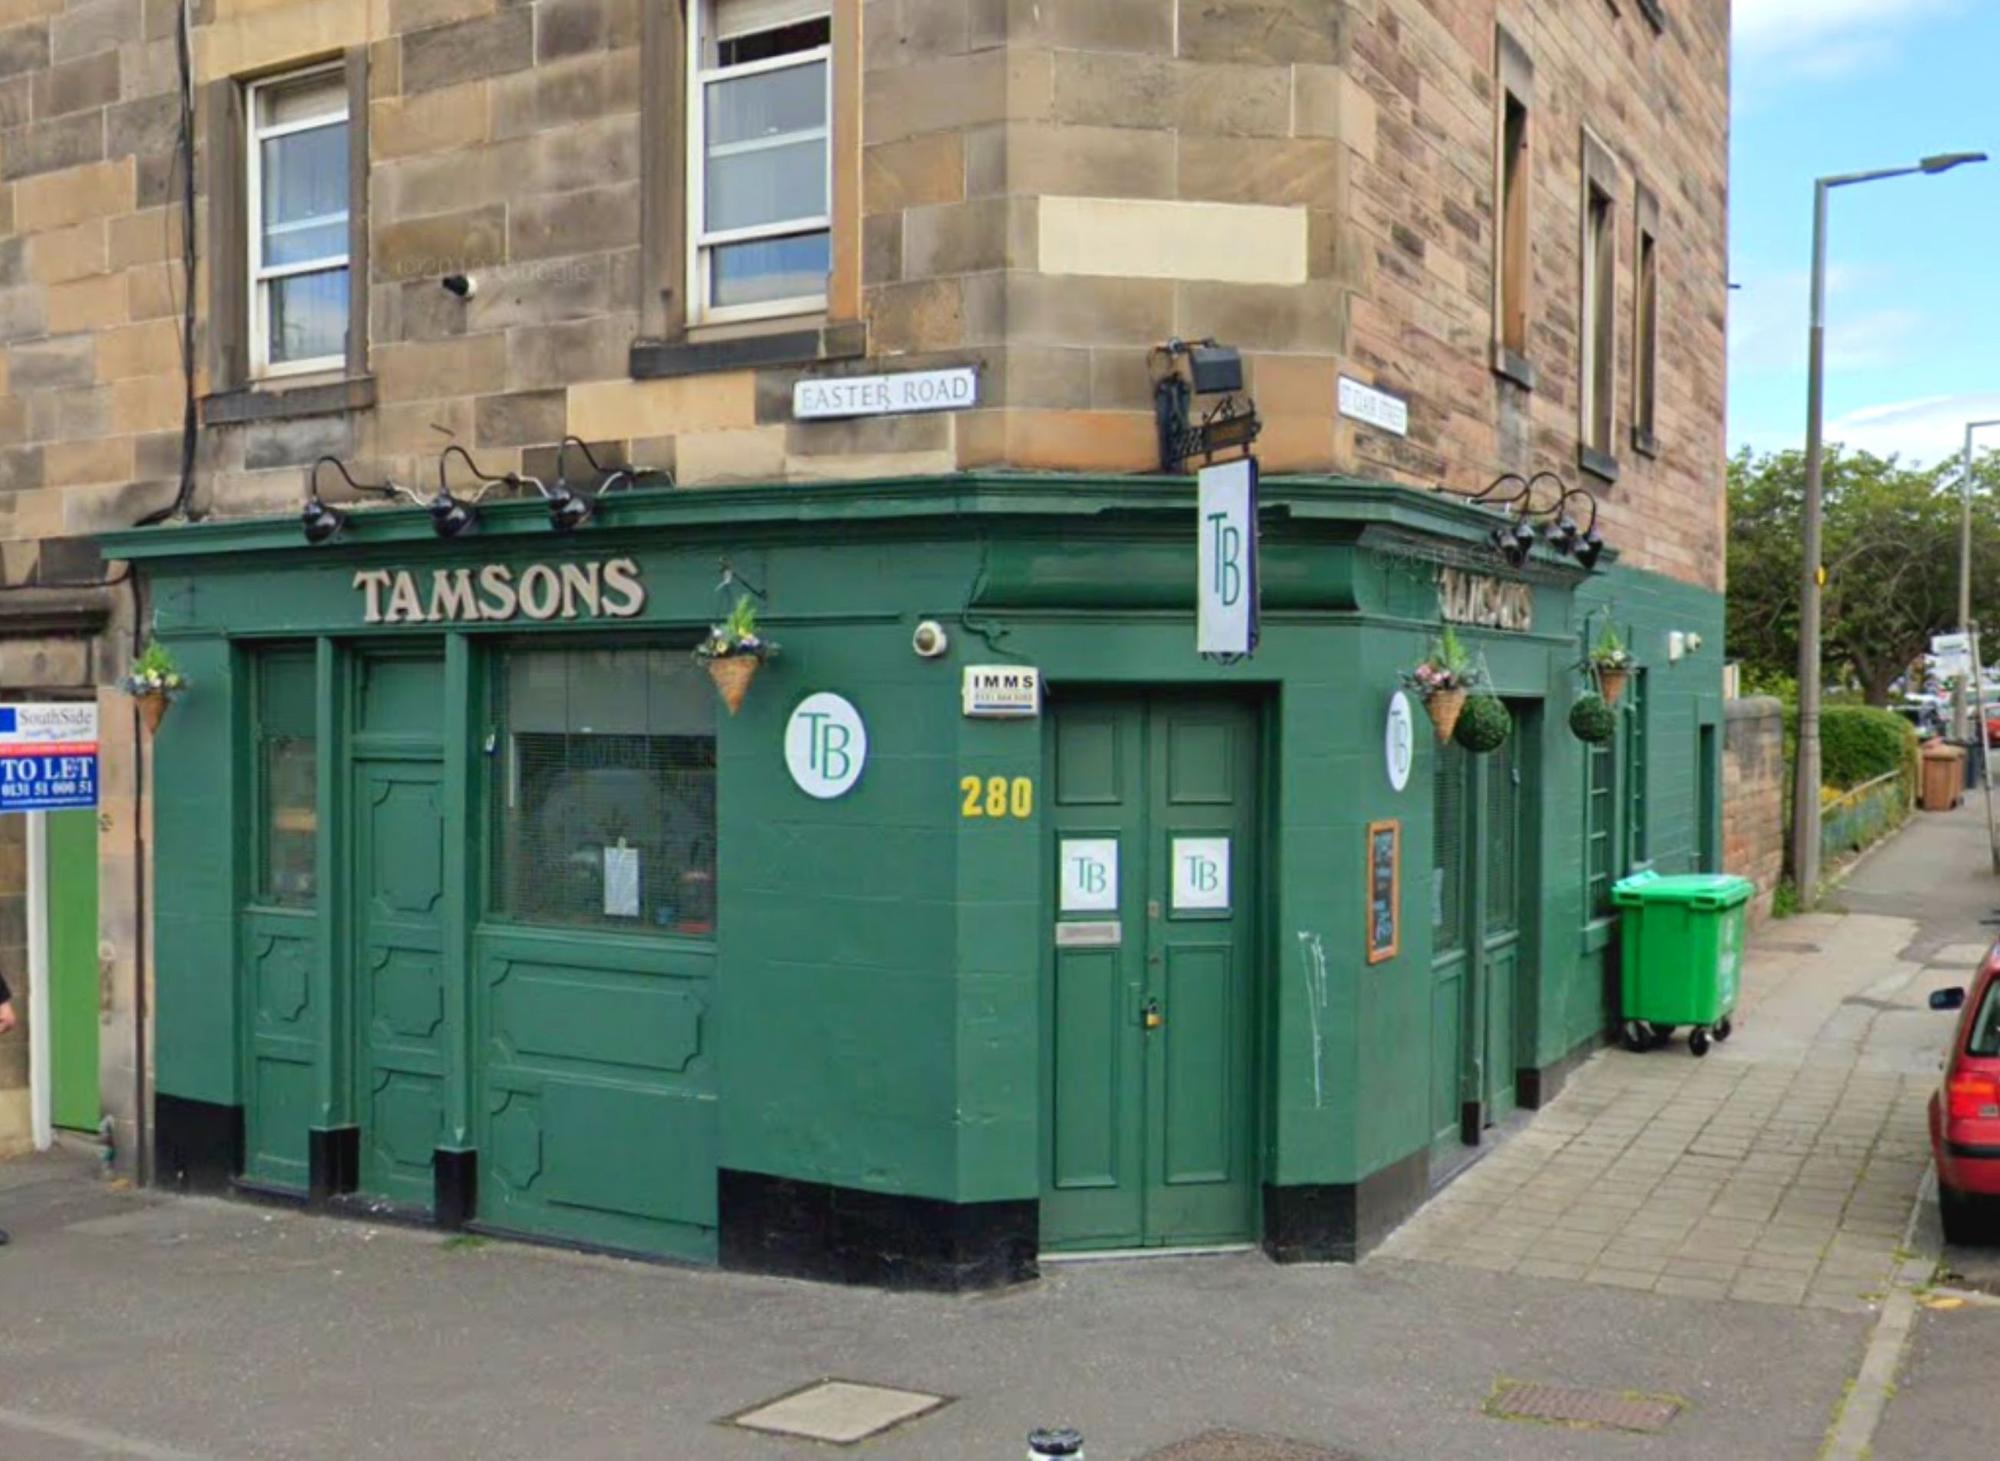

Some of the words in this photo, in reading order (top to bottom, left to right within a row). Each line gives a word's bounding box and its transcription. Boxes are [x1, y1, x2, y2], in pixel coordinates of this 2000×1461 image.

[801, 383, 893, 410] EASTER
[903, 376, 968, 404] ROAD
[1207, 511, 1240, 606] TB
[353, 558, 645, 622] TAMSONS
[974, 675, 1034, 688] IMMS
[798, 712, 850, 780] TB
[1, 758, 37, 781] TO
[43, 757, 93, 780] LET
[961, 775, 1032, 817] 280
[1072, 857, 1107, 893] TB
[1184, 855, 1218, 891] TB
